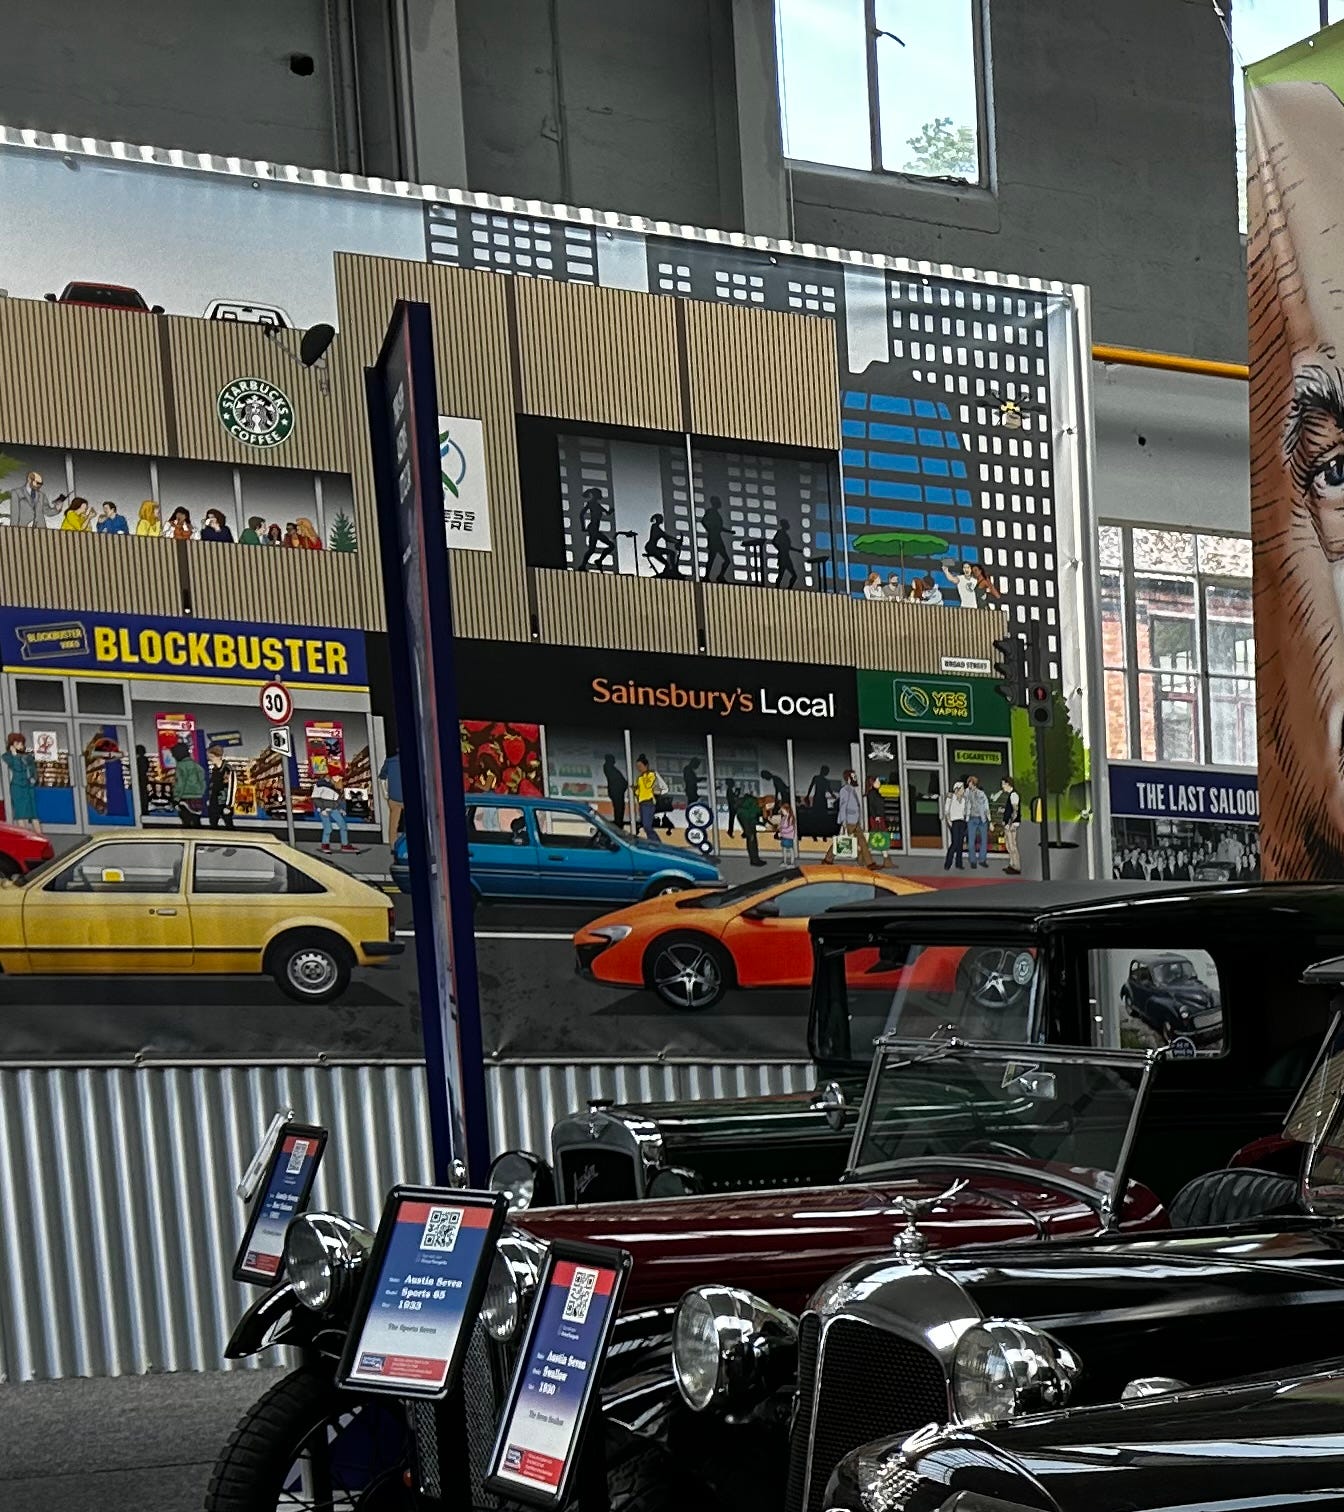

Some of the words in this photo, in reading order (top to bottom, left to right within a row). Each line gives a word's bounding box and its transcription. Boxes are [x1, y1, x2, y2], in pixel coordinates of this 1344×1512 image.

[223, 381, 289, 415] STARBUCKS
[231, 425, 281, 445] COFFEE
[93, 626, 348, 676] BLOCKBUSTER
[265, 693, 283, 712] 30
[592, 678, 753, 716] Sainsbury’s
[761, 689, 835, 718] Local
[932, 691, 967, 708] YES
[1136, 782, 1166, 811] THE
[1169, 785, 1205, 813] LAST
[404, 1274, 434, 1287] Austin
